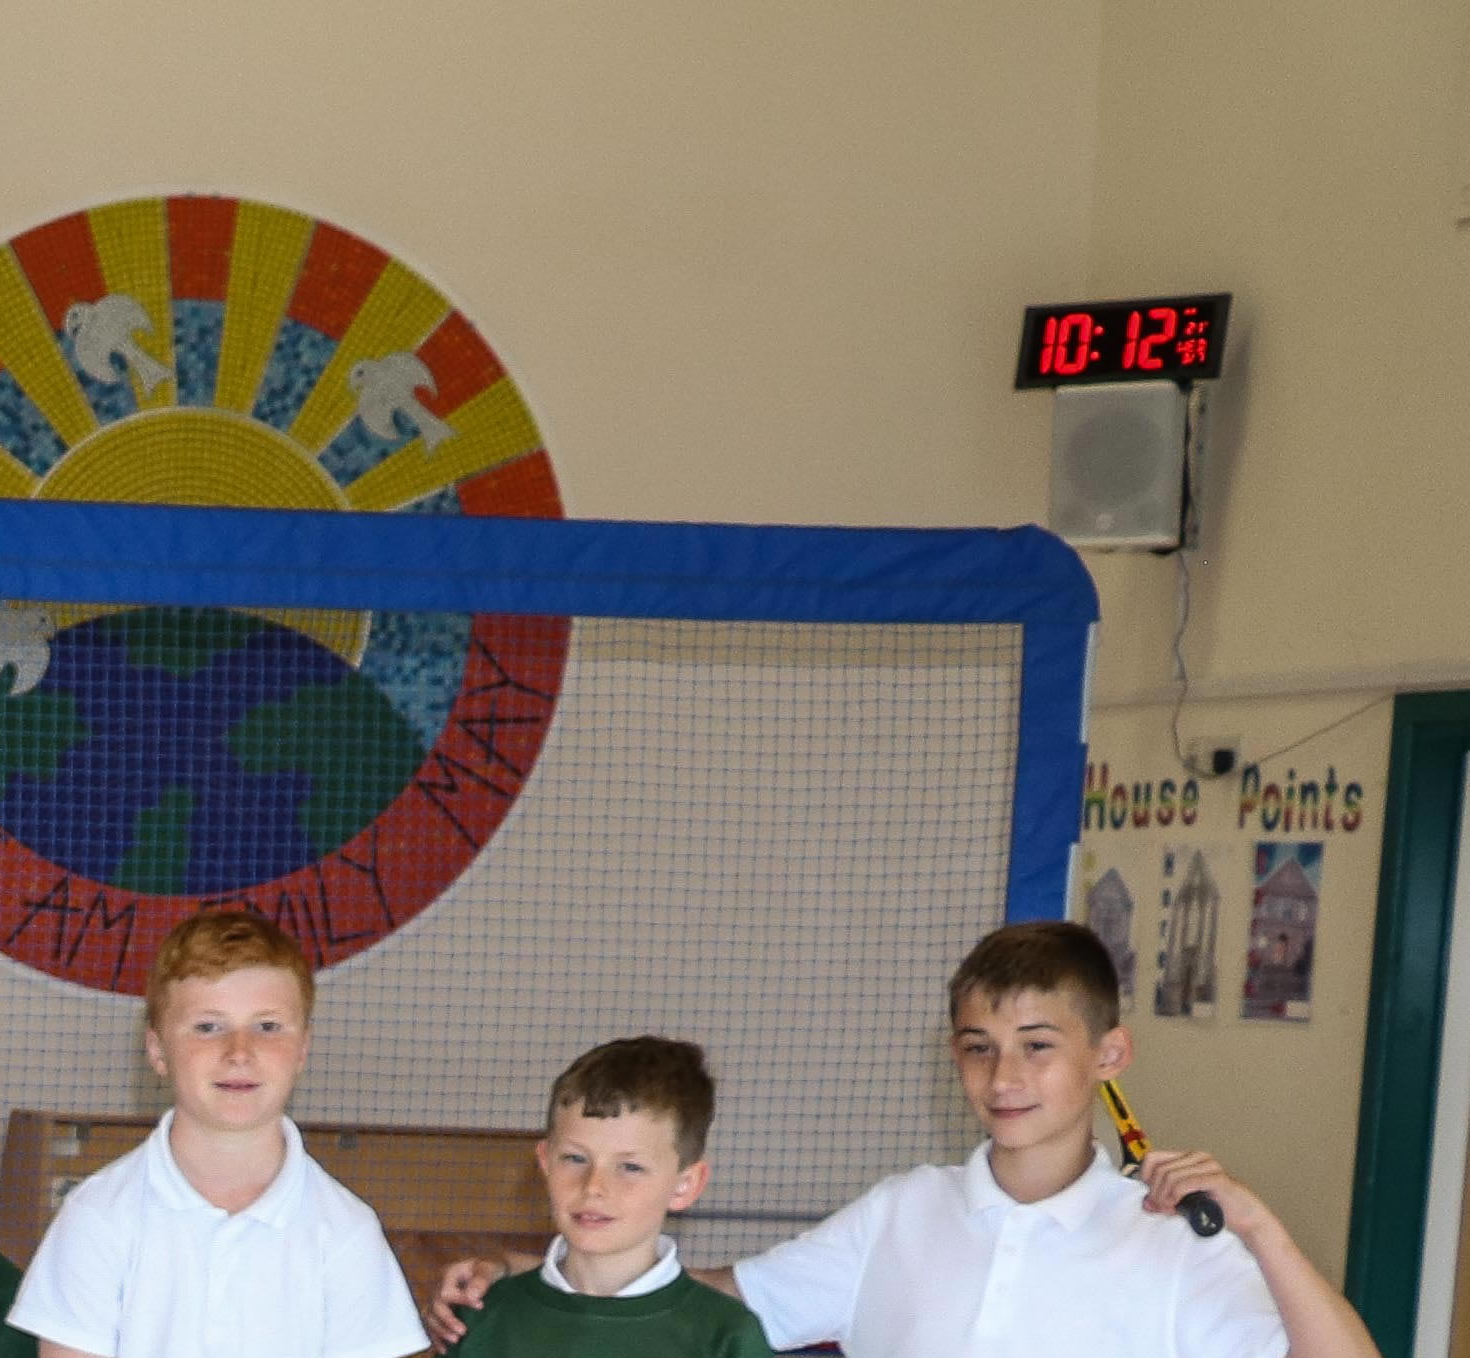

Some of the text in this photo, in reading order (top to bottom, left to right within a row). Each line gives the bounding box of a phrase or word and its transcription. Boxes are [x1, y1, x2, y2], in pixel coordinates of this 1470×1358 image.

[1040, 308, 1178, 375] 10:12
[6, 876, 136, 991] AM
[416, 640, 554, 851] MAY
[1084, 762, 1363, 832] House Points
